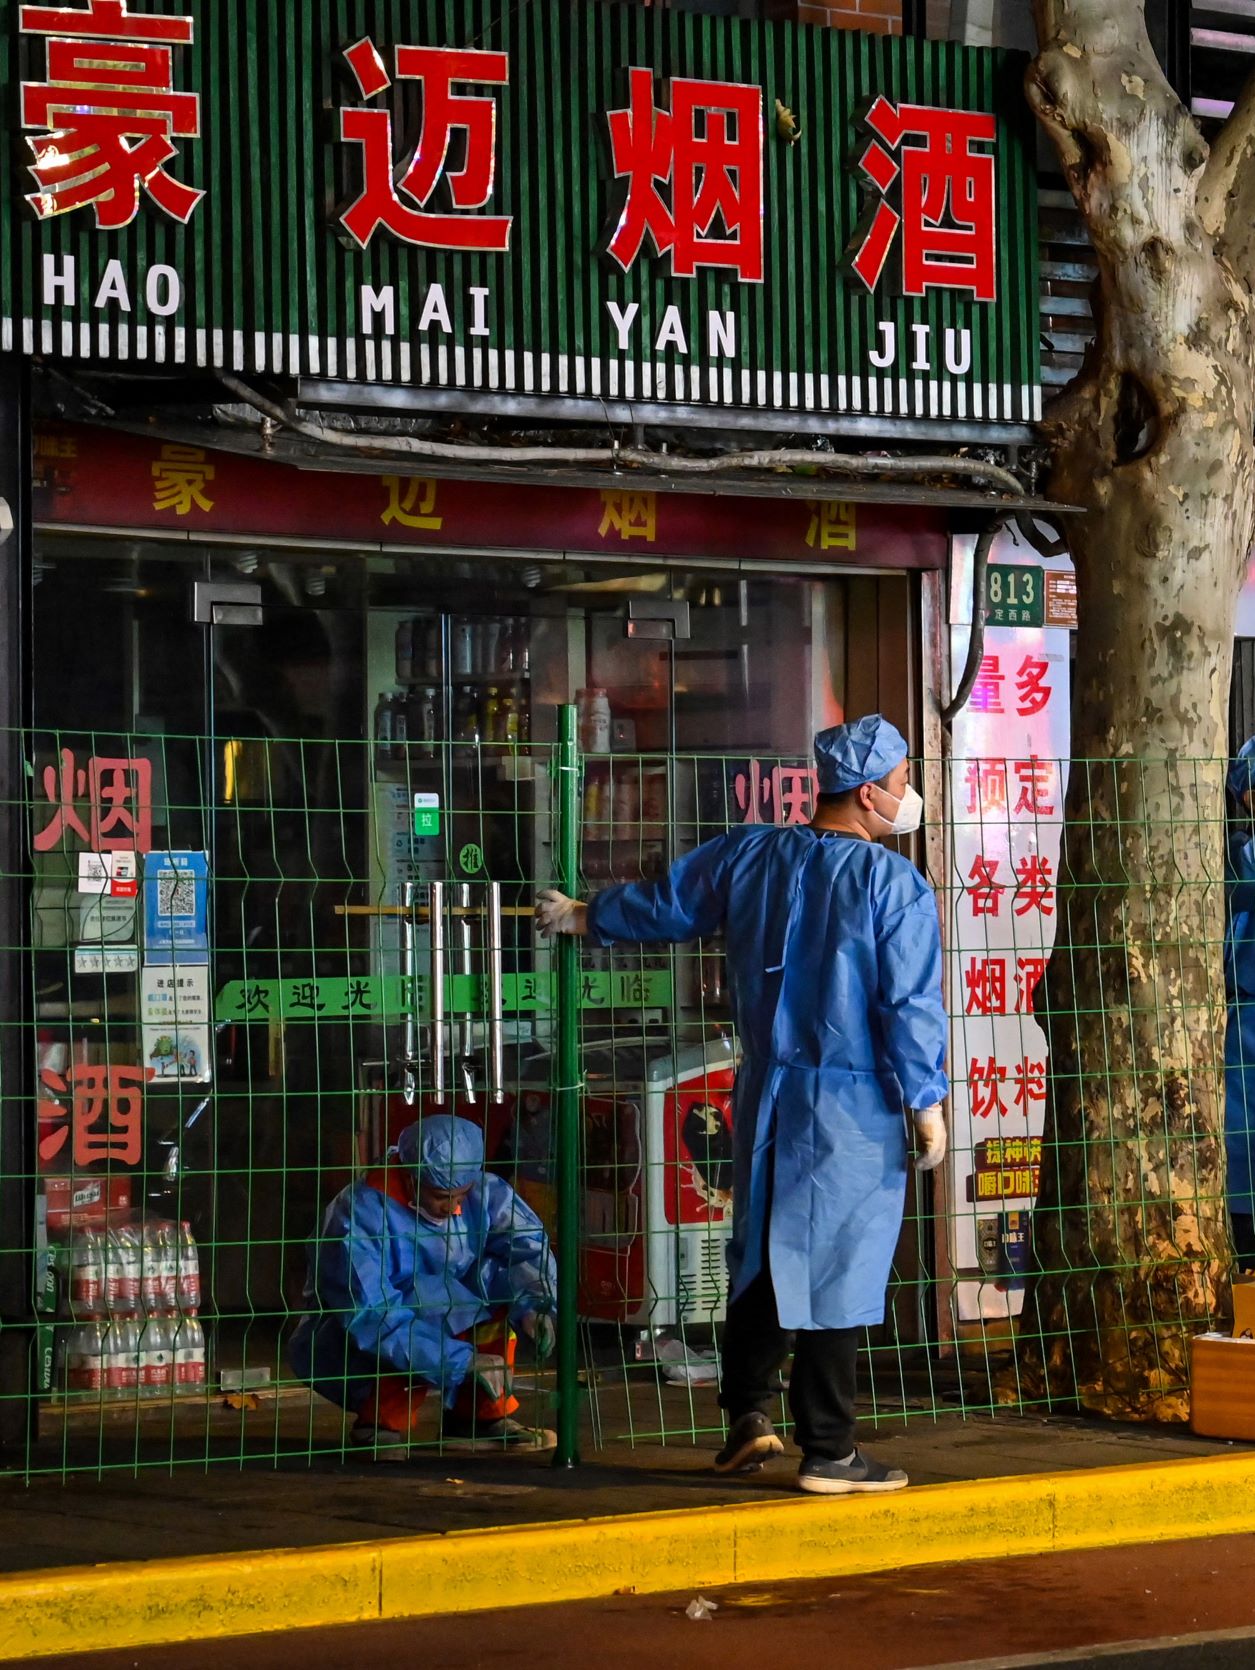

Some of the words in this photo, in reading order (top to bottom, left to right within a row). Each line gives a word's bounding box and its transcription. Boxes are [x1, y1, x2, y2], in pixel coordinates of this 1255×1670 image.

[19, 0, 997, 302] 豪迈烟酒
[43, 253, 180, 317] HAO
[361, 284, 490, 336] MAI
[606, 301, 736, 359] YAN
[869, 321, 972, 375] JIU
[989, 572, 1034, 605] 813
[995, 609, 1031, 622] 定西路
[966, 655, 1053, 717] 量多
[965, 755, 1054, 816] 预定
[968, 855, 1054, 917] 各类
[968, 1056, 1049, 1118] 饮料
